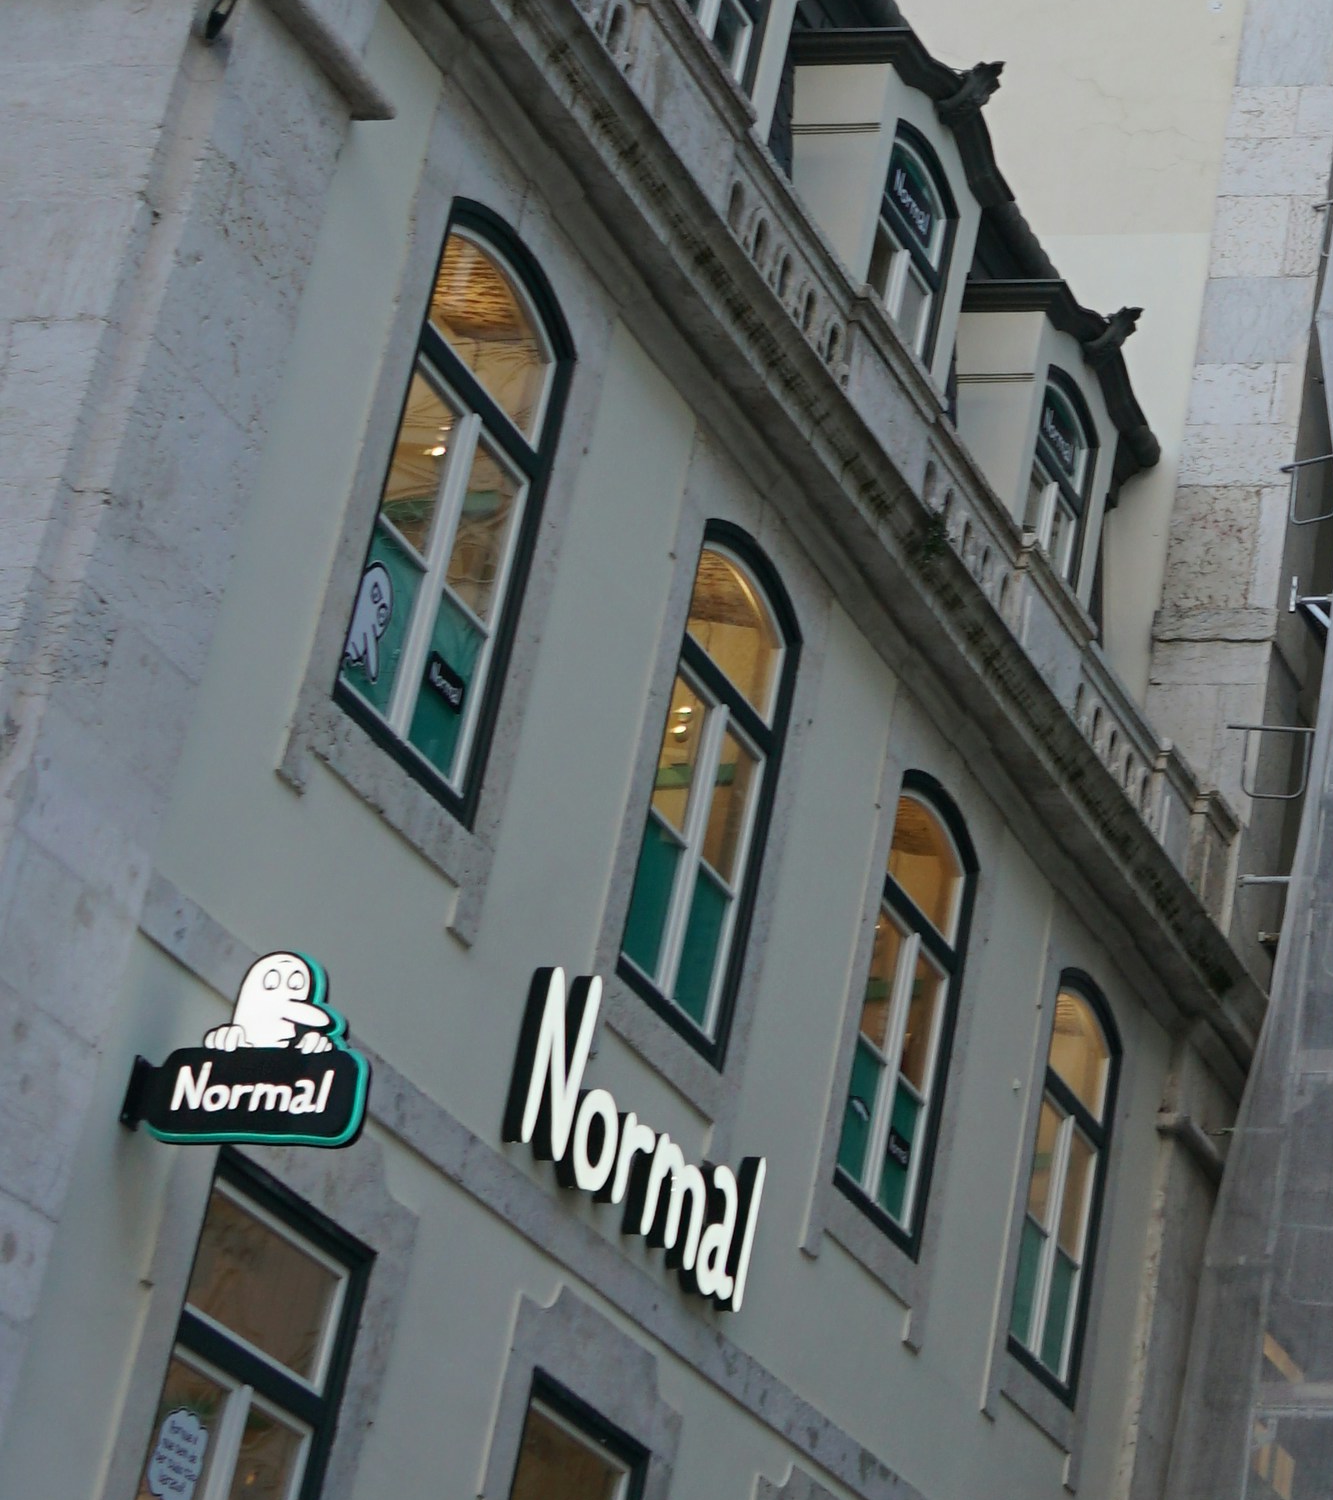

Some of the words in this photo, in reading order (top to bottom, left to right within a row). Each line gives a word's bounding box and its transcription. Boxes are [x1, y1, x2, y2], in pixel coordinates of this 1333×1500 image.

[894, 168, 931, 235] Normal
[170, 1061, 335, 1114] Normal
[521, 966, 767, 1313] Normal
